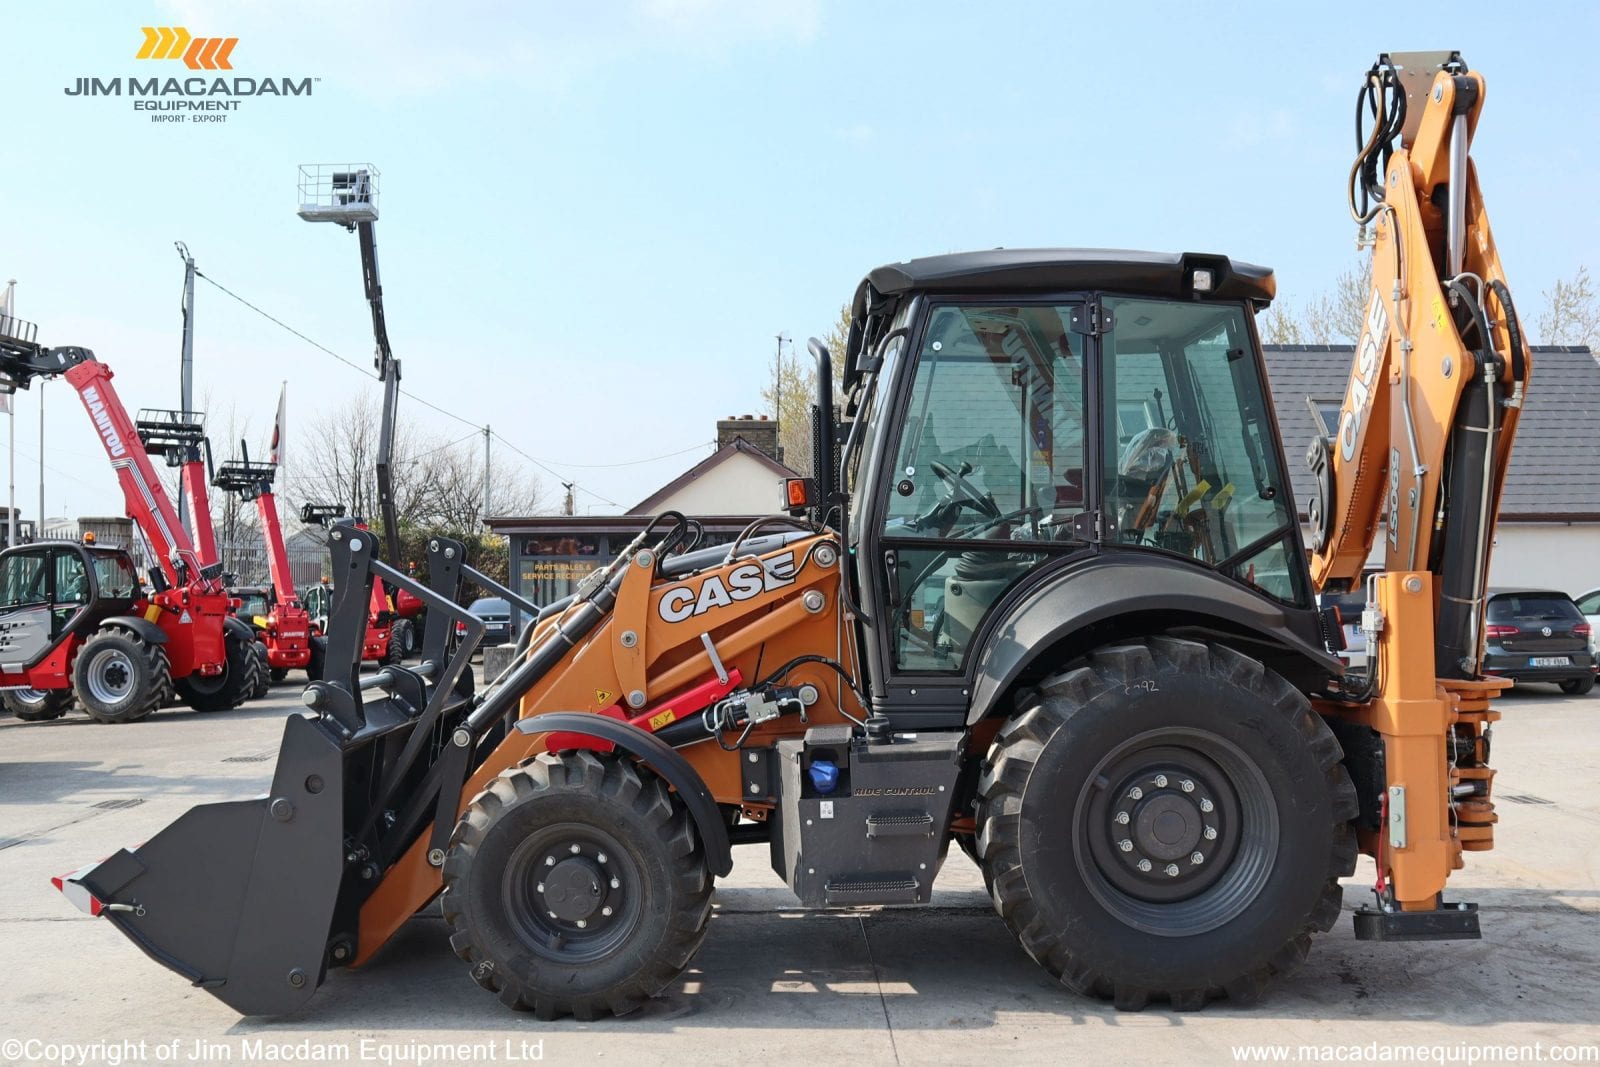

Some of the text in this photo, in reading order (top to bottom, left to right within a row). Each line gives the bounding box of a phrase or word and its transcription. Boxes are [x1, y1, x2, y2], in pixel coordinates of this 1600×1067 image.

[1341, 286, 1388, 462] CASE
[82, 385, 127, 457] MANITOU
[522, 572, 554, 580] SERVICE
[534, 563, 558, 571] PARTS
[658, 551, 796, 624] CASE
[854, 786, 936, 797] RIDE CONTROL
